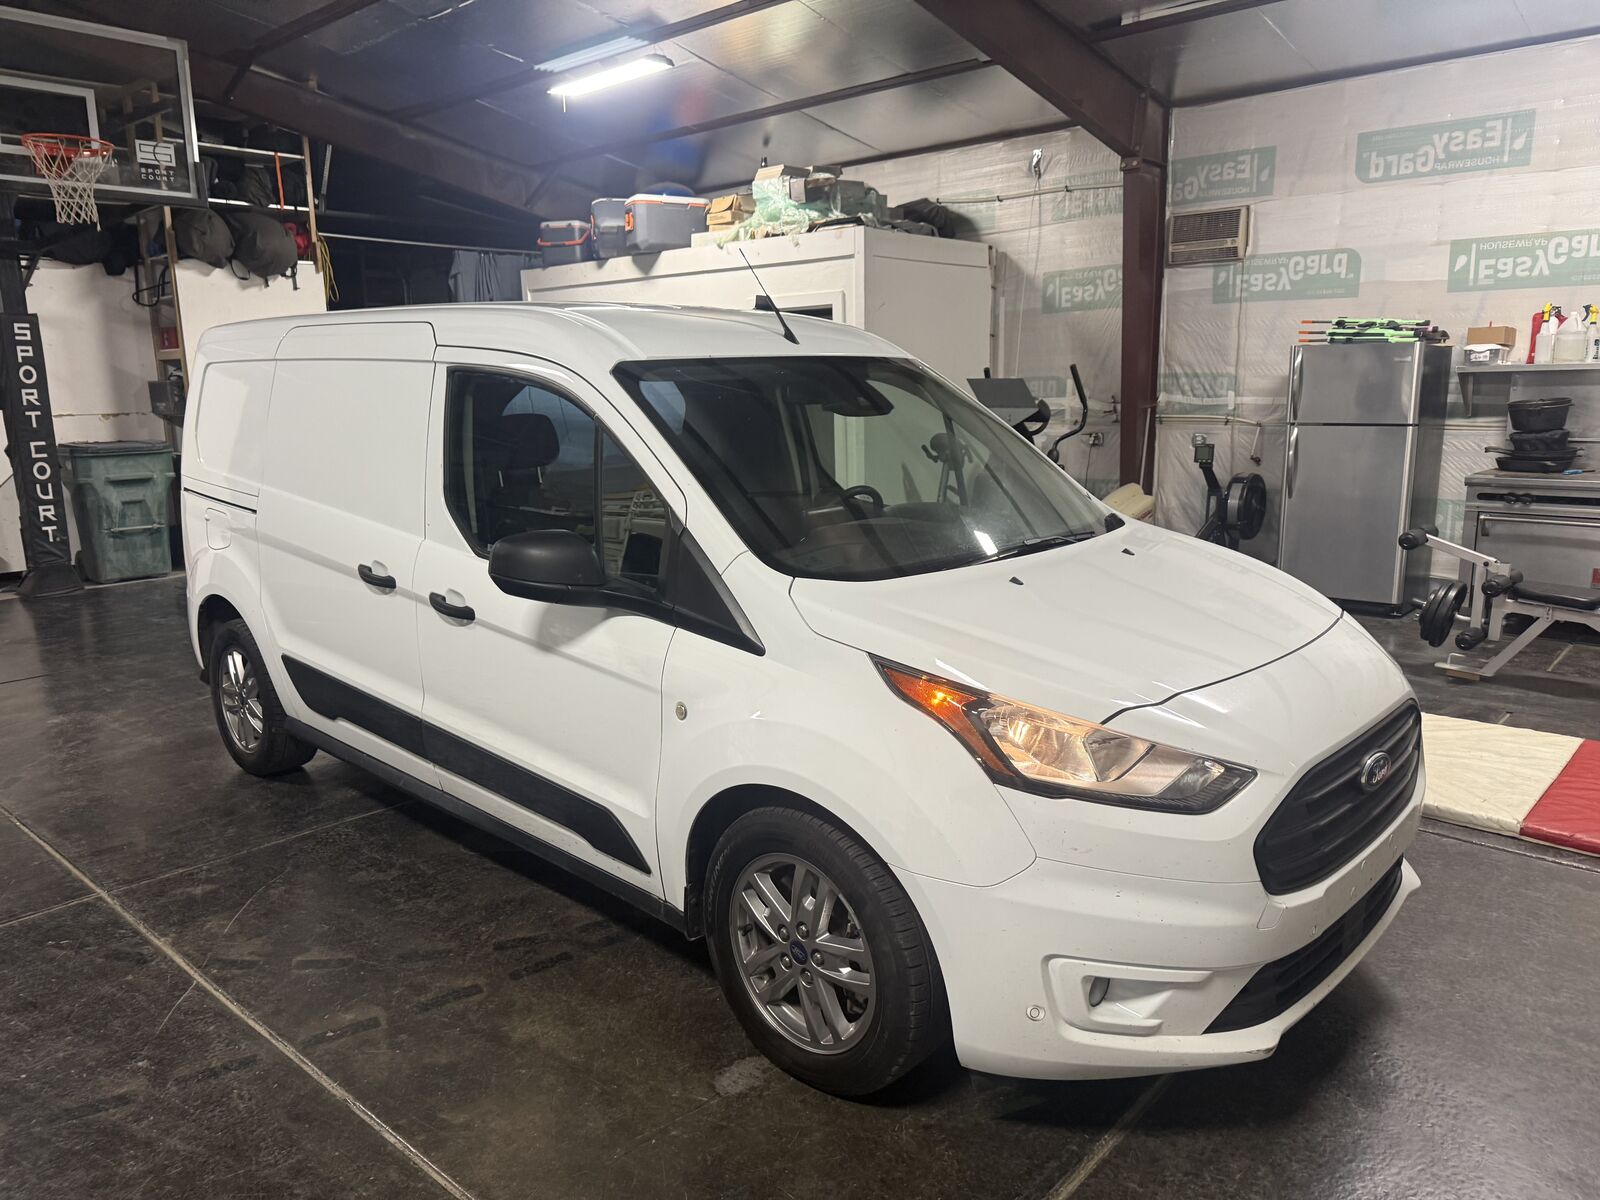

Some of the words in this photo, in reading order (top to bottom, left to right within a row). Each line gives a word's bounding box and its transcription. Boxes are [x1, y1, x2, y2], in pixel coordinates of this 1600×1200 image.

[140, 167, 175, 176] SPORT
[141, 173, 175, 182] COURT
[13, 322, 42, 429] SPORT
[29, 440, 58, 543] COURT
